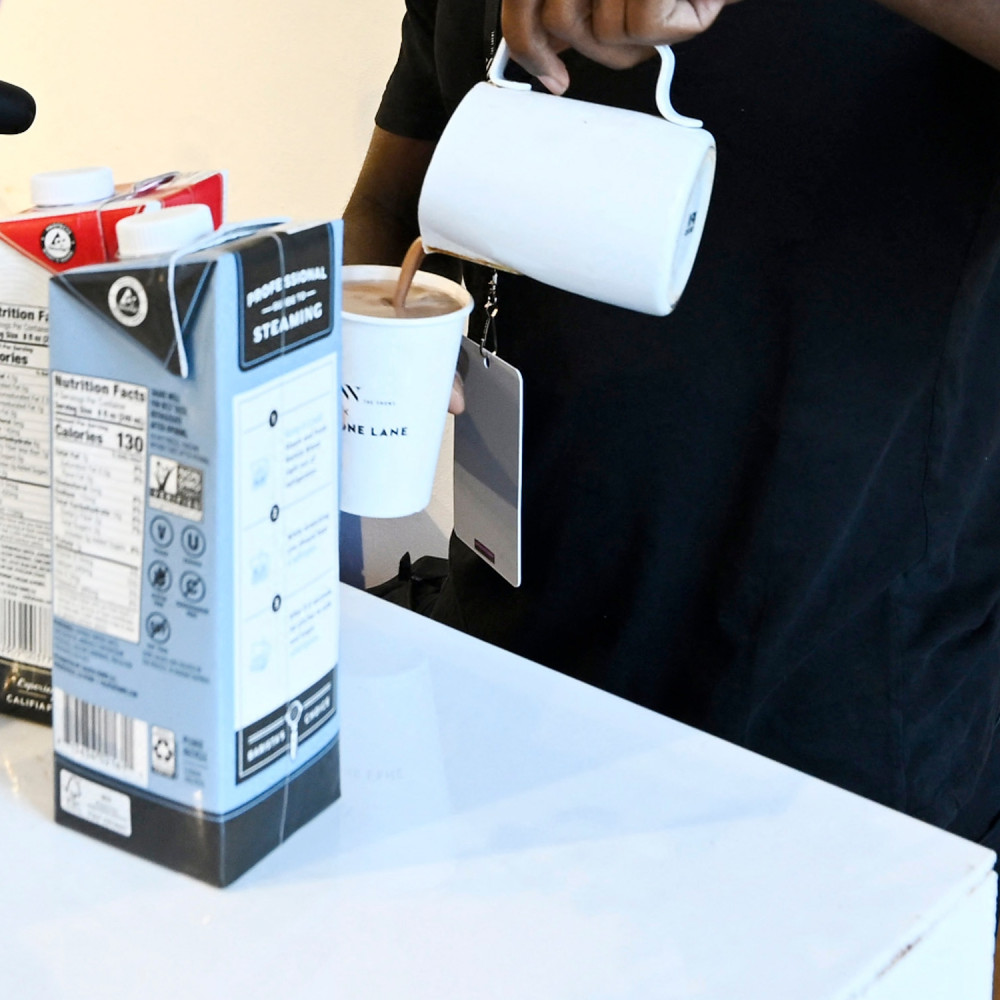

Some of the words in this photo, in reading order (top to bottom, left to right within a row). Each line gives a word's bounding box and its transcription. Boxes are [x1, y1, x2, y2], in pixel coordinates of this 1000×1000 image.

[246, 265, 328, 309] PROFESSIONAL
[252, 301, 324, 344] STEAMING
[54, 375, 110, 396] Nutrition
[113, 384, 146, 403] Facts
[55, 423, 103, 445] Calories
[117, 432, 144, 454] 130
[370, 426, 408, 437] LANE
